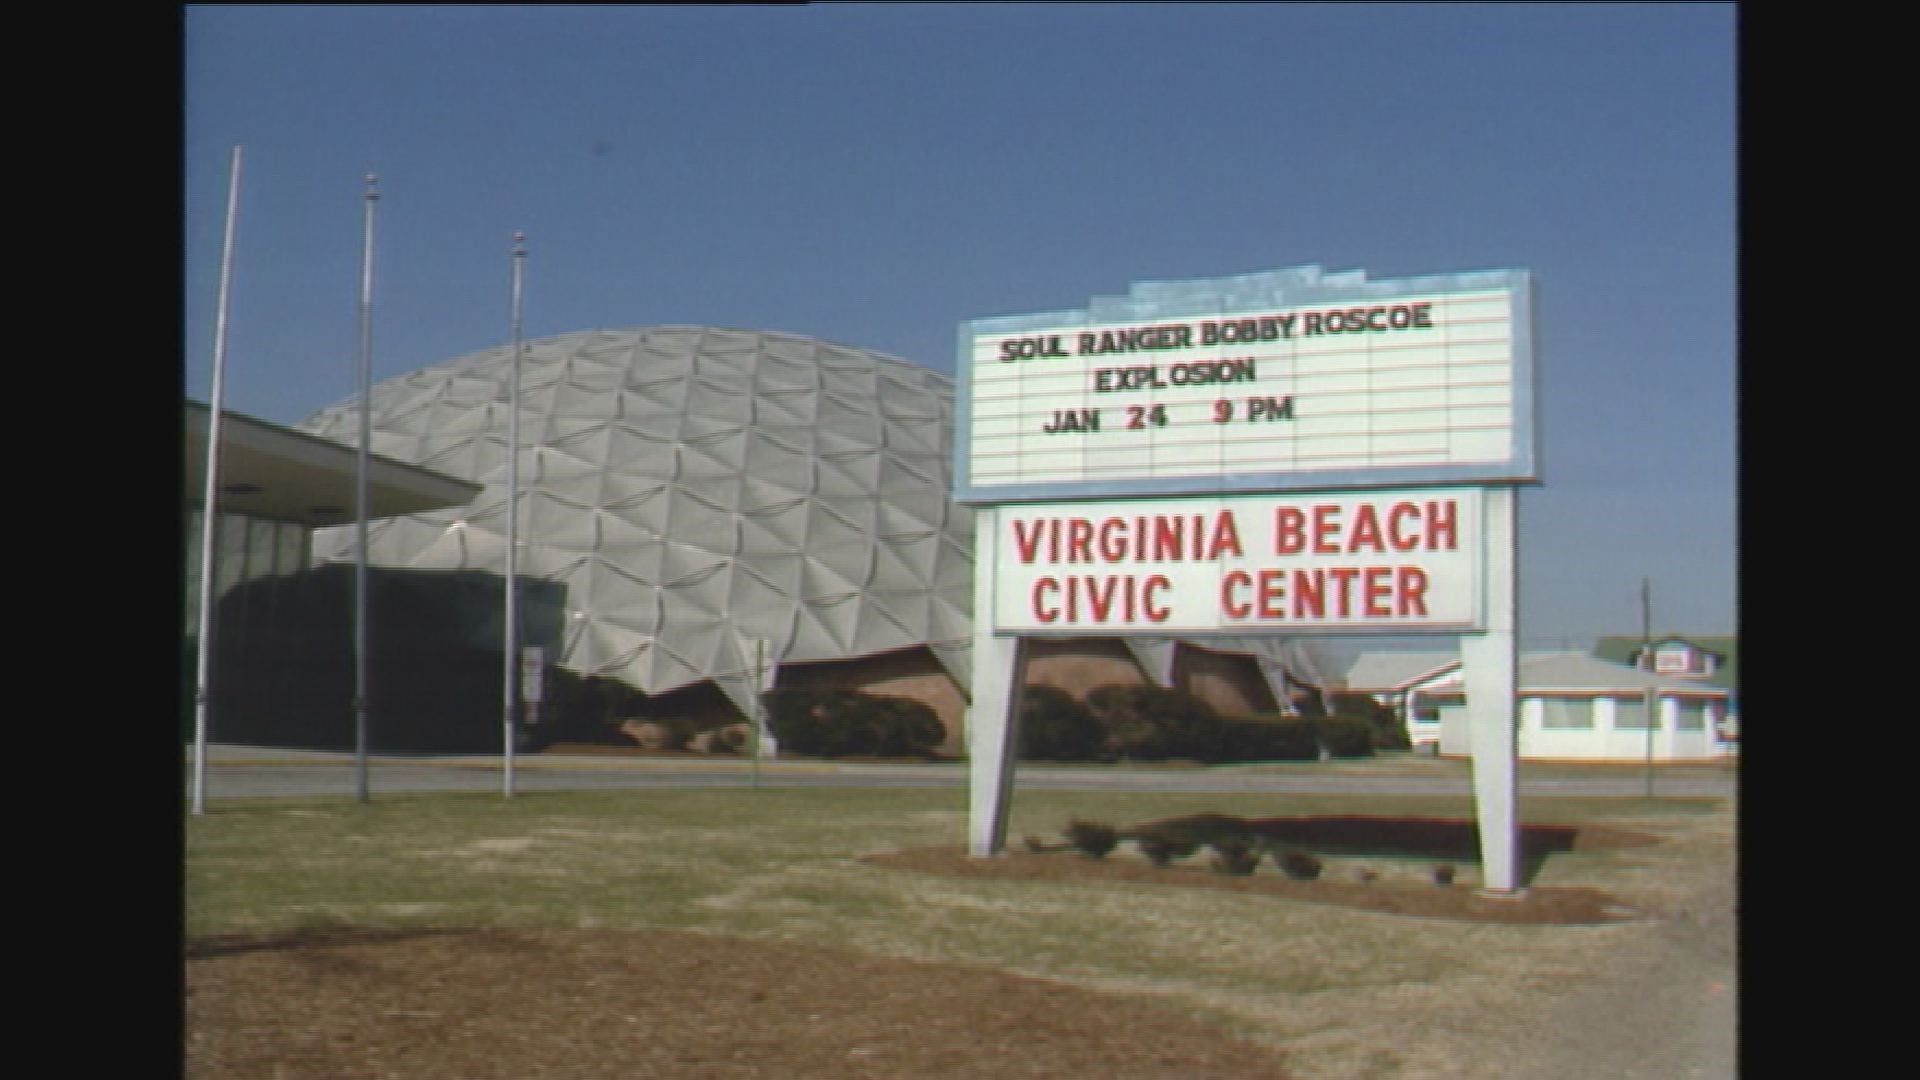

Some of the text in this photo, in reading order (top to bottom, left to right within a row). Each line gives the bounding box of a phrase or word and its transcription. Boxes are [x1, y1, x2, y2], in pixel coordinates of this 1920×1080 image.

[999, 302, 1433, 362] SOUL RANGER BOBBY ROSCOE
[1043, 394, 1294, 434] JAN 24 9 PM
[1012, 498, 1458, 564] VIRGINIA BEACH
[1031, 565, 1430, 623] CIVIC CENTER
